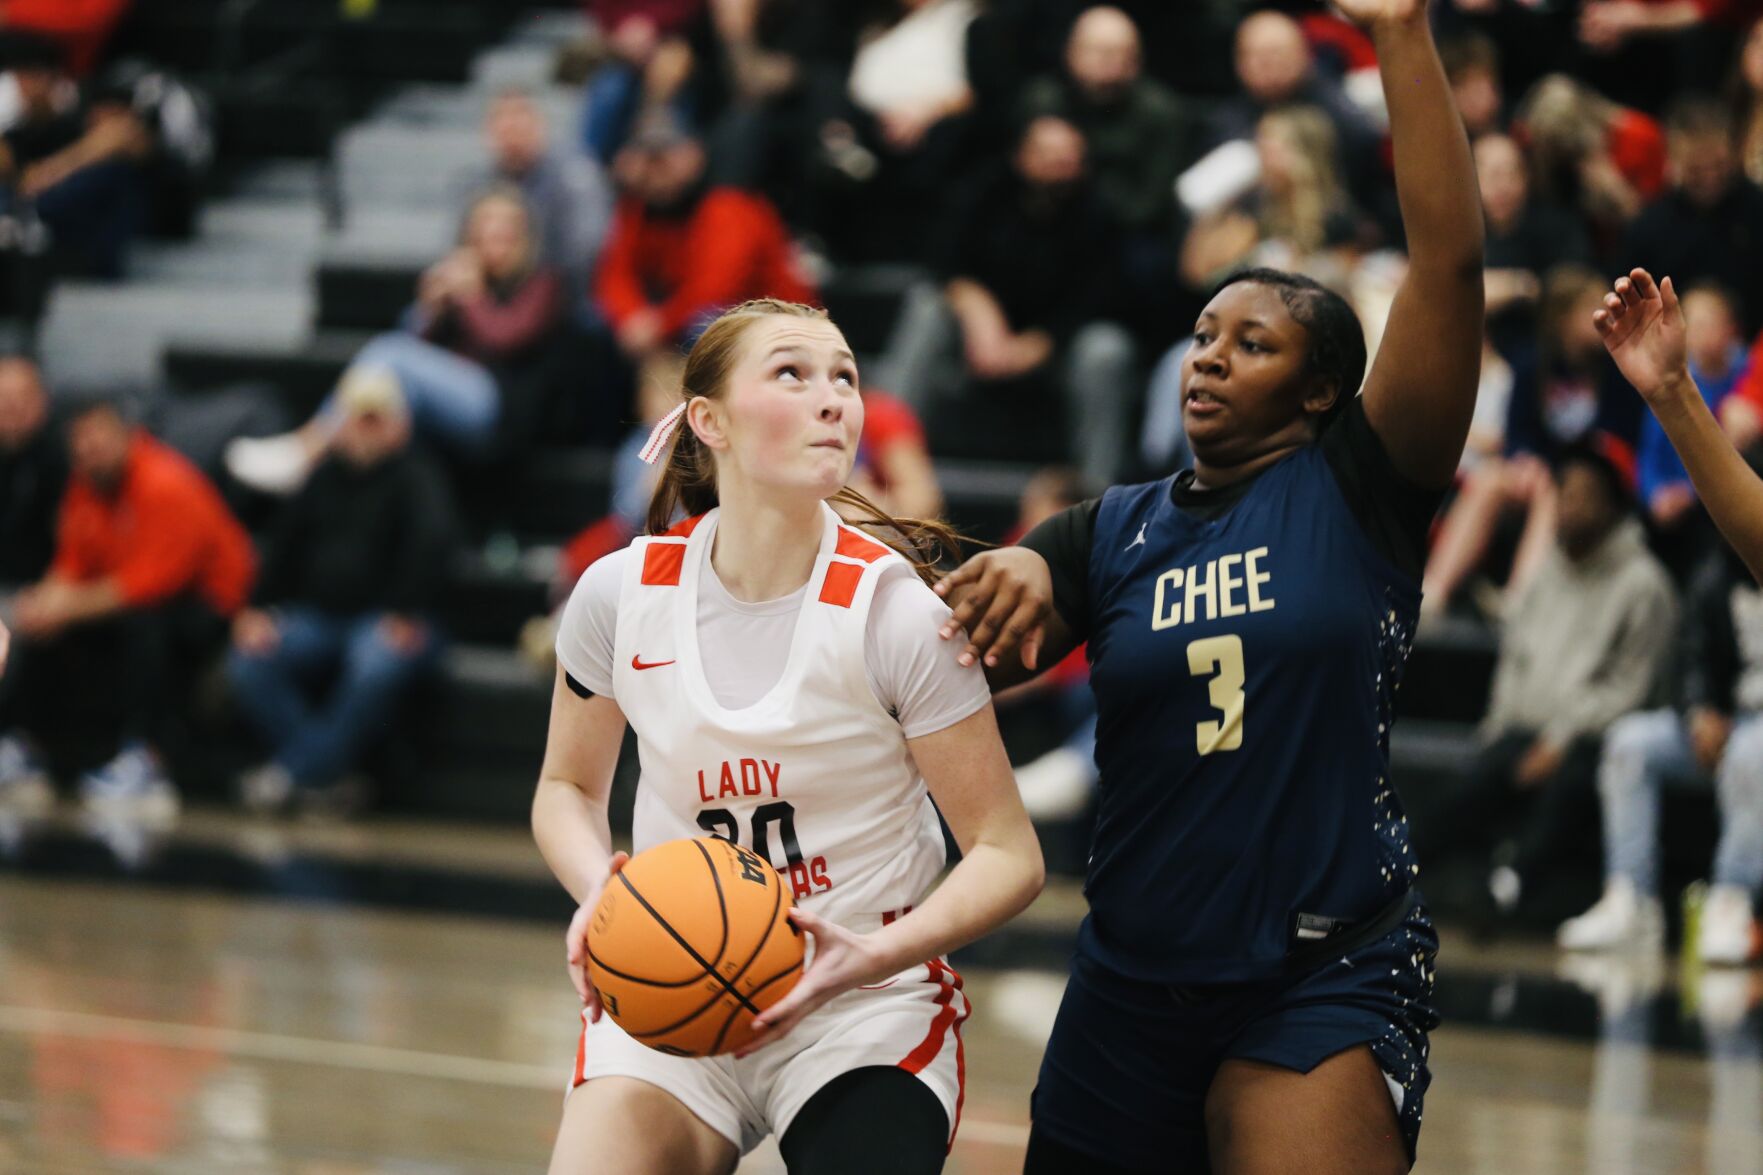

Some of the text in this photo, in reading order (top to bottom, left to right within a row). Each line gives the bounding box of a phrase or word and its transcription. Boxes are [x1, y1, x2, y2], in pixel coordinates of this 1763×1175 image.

[1151, 546, 1275, 631] CHEE
[1186, 633, 1245, 756] 3
[698, 758, 781, 803] LADY
[776, 856, 832, 899] RS
